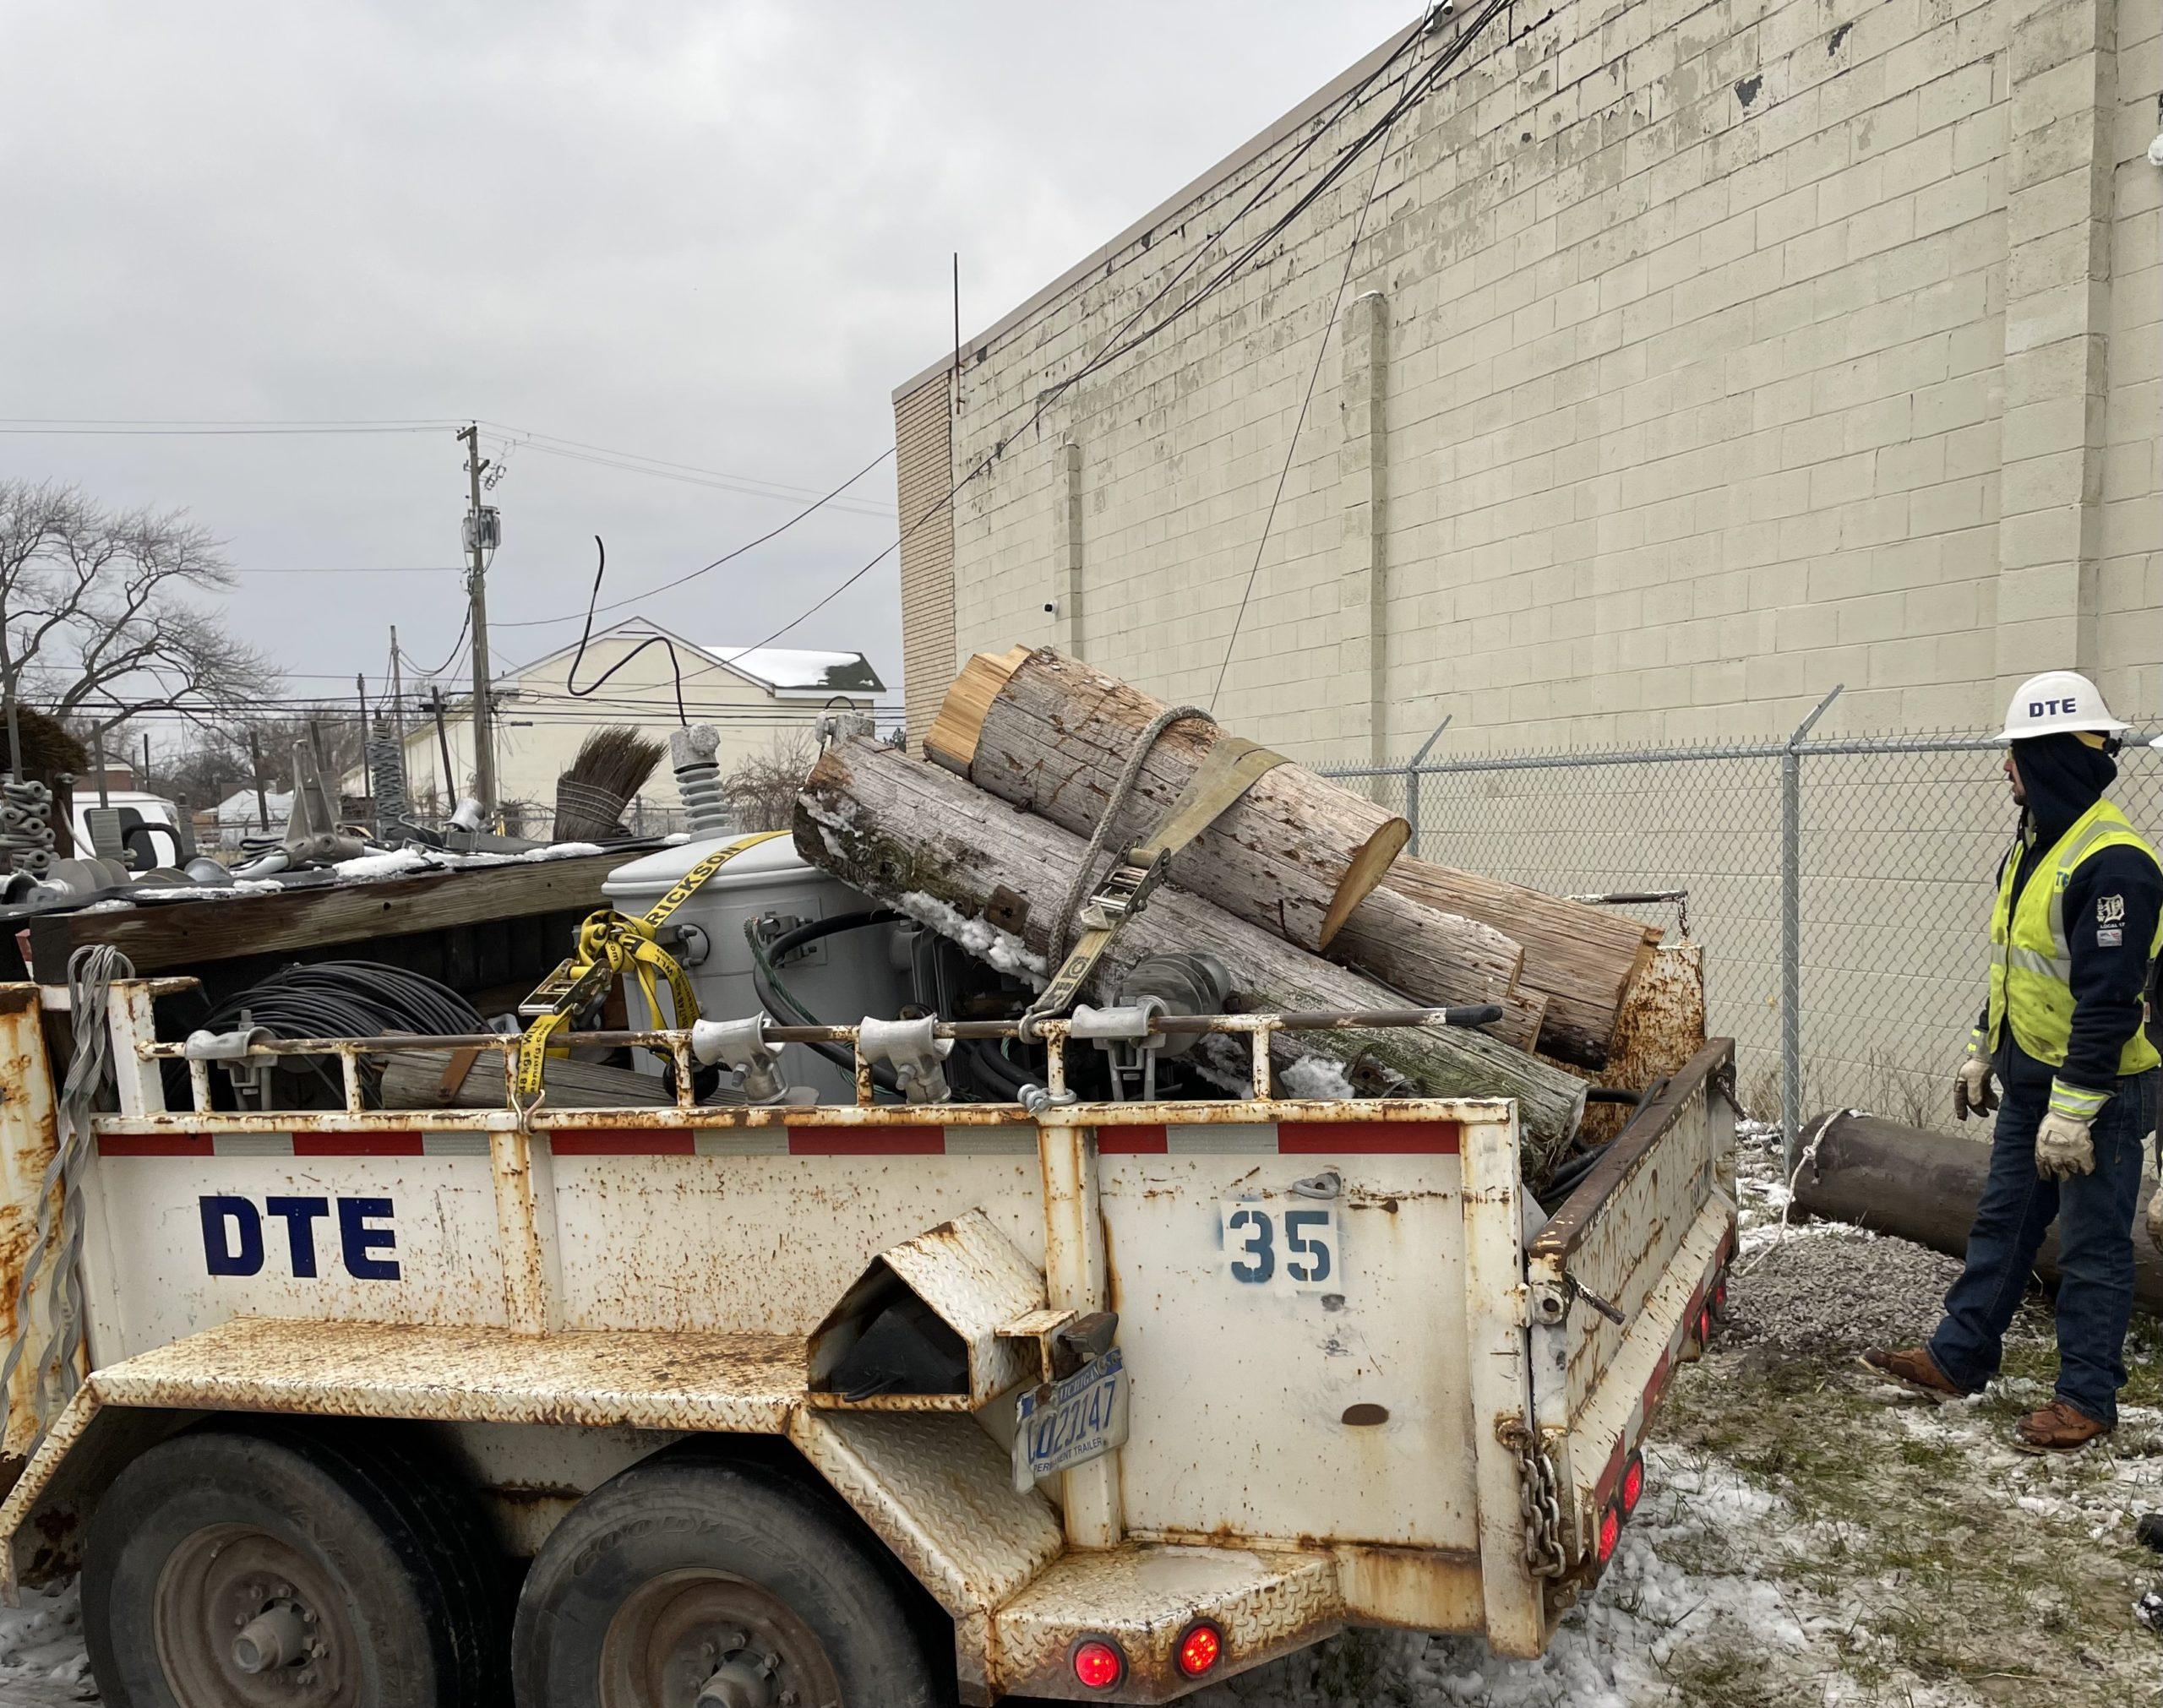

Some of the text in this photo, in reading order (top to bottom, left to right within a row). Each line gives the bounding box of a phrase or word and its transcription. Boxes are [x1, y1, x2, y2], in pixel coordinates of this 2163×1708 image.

[2030, 698, 2076, 717] DTE
[523, 1023, 542, 1045] WLL
[199, 1195, 400, 1281] DTE
[1229, 1210, 1331, 1283] 35
[1073, 1437, 1102, 1456] TRAILER
